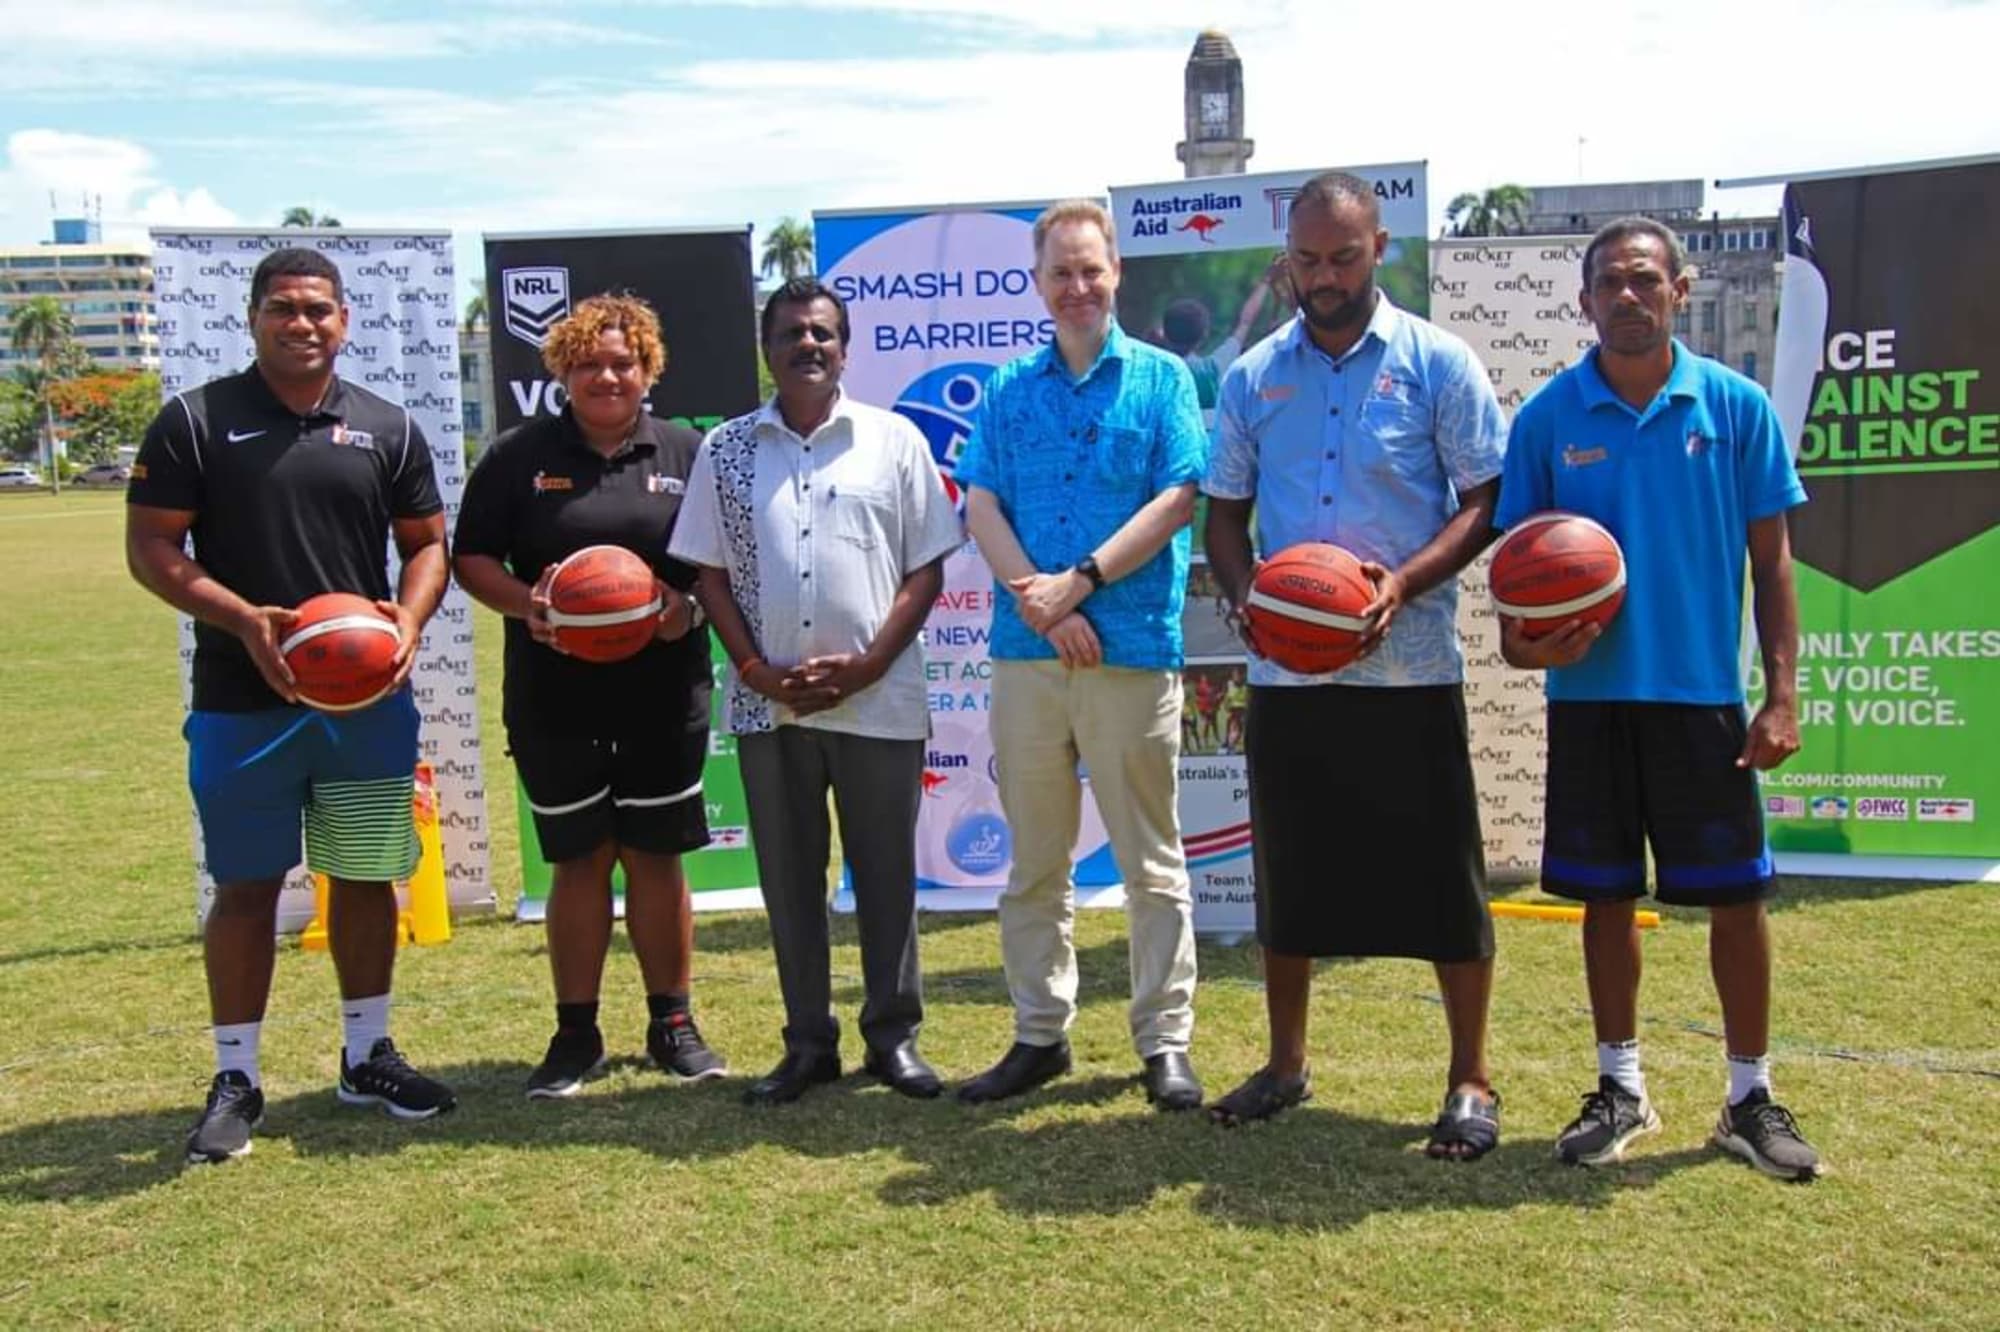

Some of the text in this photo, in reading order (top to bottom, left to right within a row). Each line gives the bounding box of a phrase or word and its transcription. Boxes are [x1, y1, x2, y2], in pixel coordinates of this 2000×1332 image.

[1131, 193, 1242, 217] Australian
[1132, 218, 1168, 237] Aid
[317, 236, 369, 251] CRICKET
[394, 236, 445, 251] CRICKET
[1453, 244, 1584, 263] CRICKET CRICK
[357, 260, 409, 278] CRICKET
[514, 277, 560, 296] NRL
[833, 269, 1034, 301] SMASH DO
[1495, 273, 1554, 292] CRICKET
[161, 287, 449, 305] CRICKET CRICKET
[361, 312, 414, 331] CRICKET
[1450, 303, 1509, 322] CRICKET
[875, 320, 1056, 351] BARRIERS
[1491, 331, 1550, 351] CRICKET
[165, 341, 220, 358] CRICKET
[401, 339, 451, 356] CRICKET
[365, 366, 416, 383] CRICKET
[1811, 370, 1980, 416] AINST
[1799, 415, 2000, 462] OLENCE
[935, 591, 979, 611] AVE
[1883, 630, 2000, 658] TAKES
[926, 662, 953, 681] ET
[1821, 665, 1939, 697] VOICE,
[424, 708, 471, 725] CRICKET
[1846, 700, 1966, 726] VOICE.
[1178, 765, 1239, 781] stralia's
[1204, 874, 1245, 887] Team
[1198, 892, 1222, 903] the
